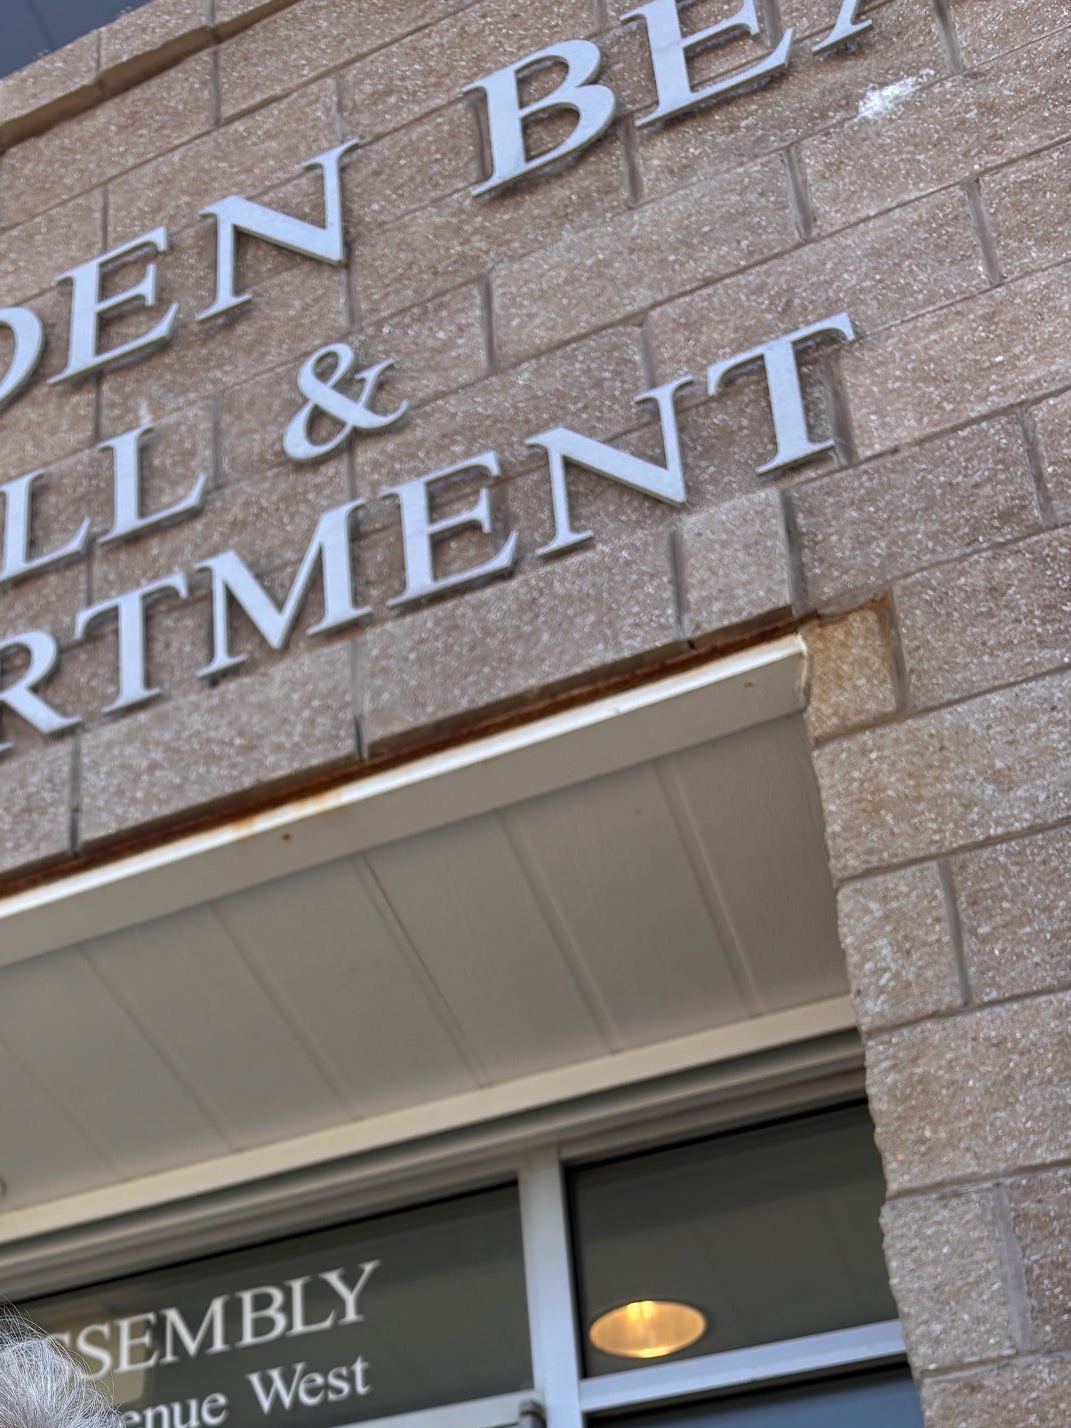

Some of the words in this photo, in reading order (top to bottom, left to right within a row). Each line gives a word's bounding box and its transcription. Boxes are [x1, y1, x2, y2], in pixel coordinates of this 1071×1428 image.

[283, 342, 410, 460] &
[57, 1259, 381, 1382] SEMBLY
[244, 1355, 371, 1414] West
